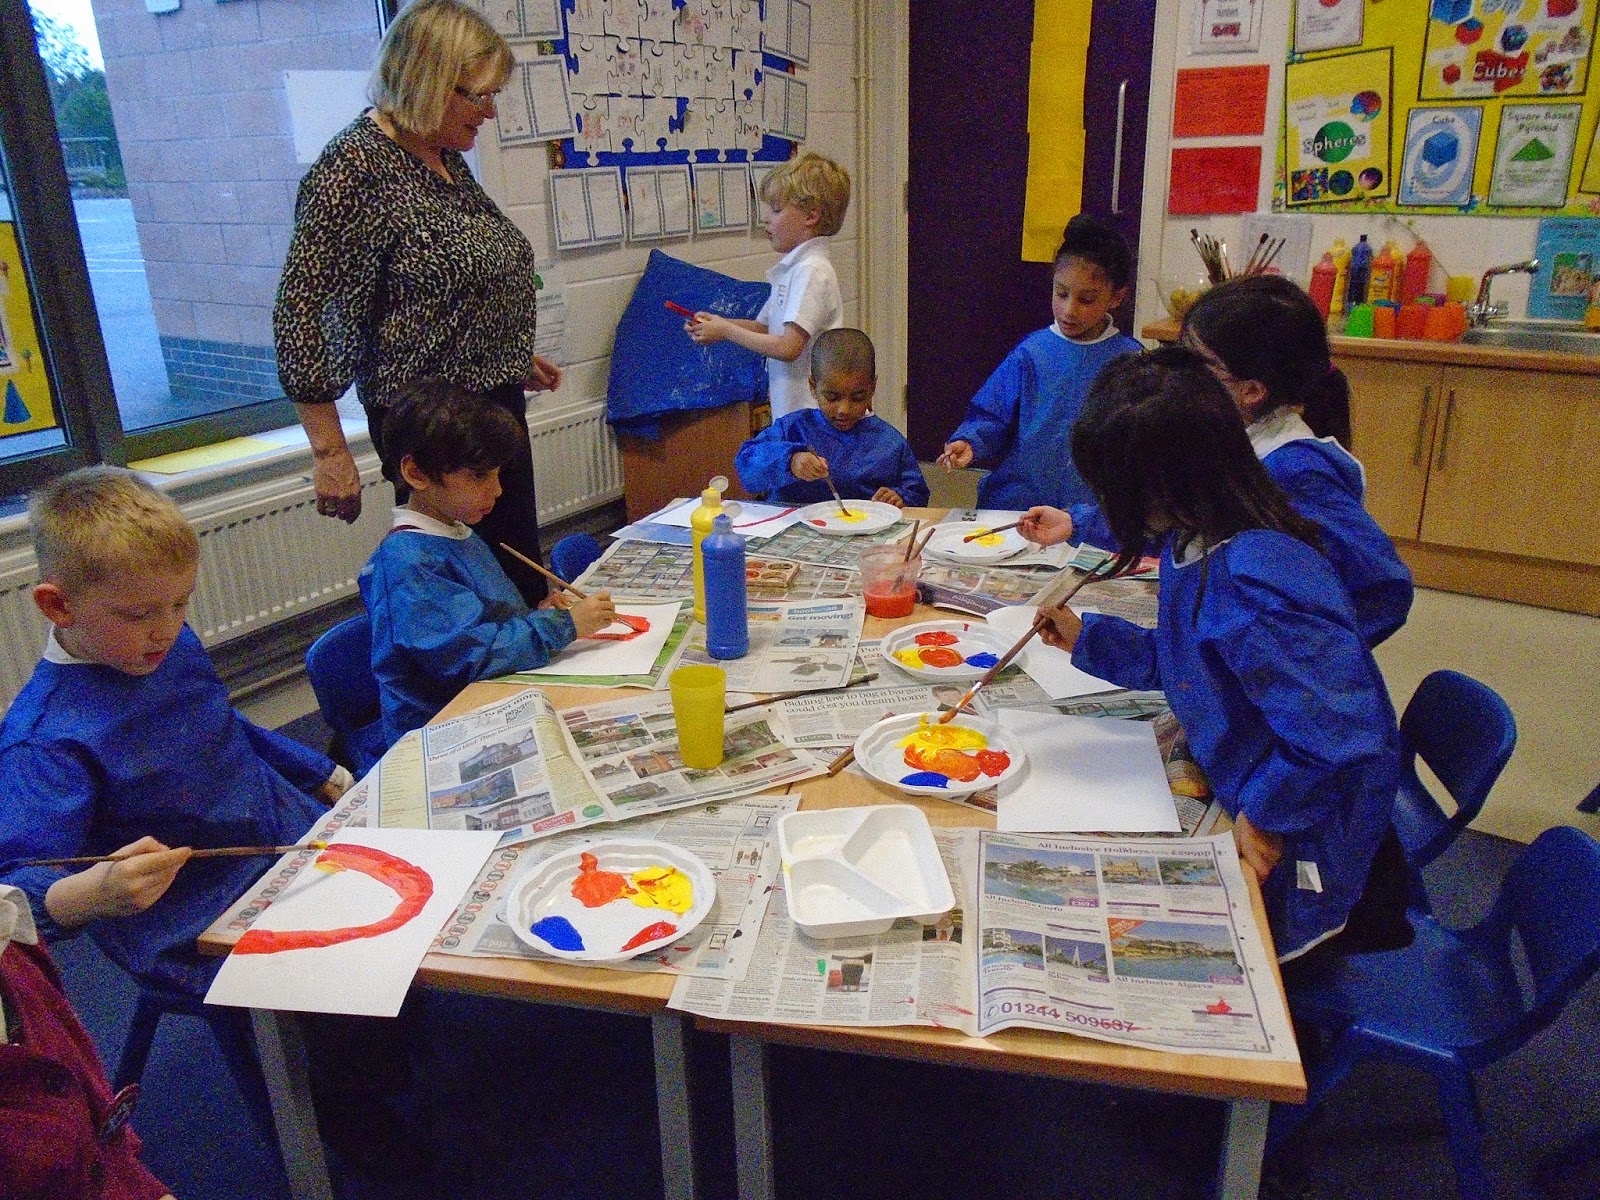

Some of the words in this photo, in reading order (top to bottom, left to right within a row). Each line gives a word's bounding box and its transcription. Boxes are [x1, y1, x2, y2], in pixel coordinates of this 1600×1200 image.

[1432, 114, 1455, 124] Cube
[1303, 133, 1366, 157] Spheres
[497, 704, 512, 715] get
[514, 693, 540, 705] more
[784, 698, 824, 708] Bidding
[888, 688, 928, 696] bargain
[786, 704, 815, 713] could
[817, 702, 838, 710] cost
[839, 701, 860, 709] you
[861, 696, 896, 705] dream
[897, 693, 929, 701] home
[1054, 844, 1101, 852] Inclusive
[998, 896, 1035, 906] Inclusive
[983, 966, 1014, 974] Tenerife
[1130, 978, 1175, 987] Inclusive
[1178, 981, 1214, 990] Algarve
[1001, 1002, 1060, 1018] 01244
